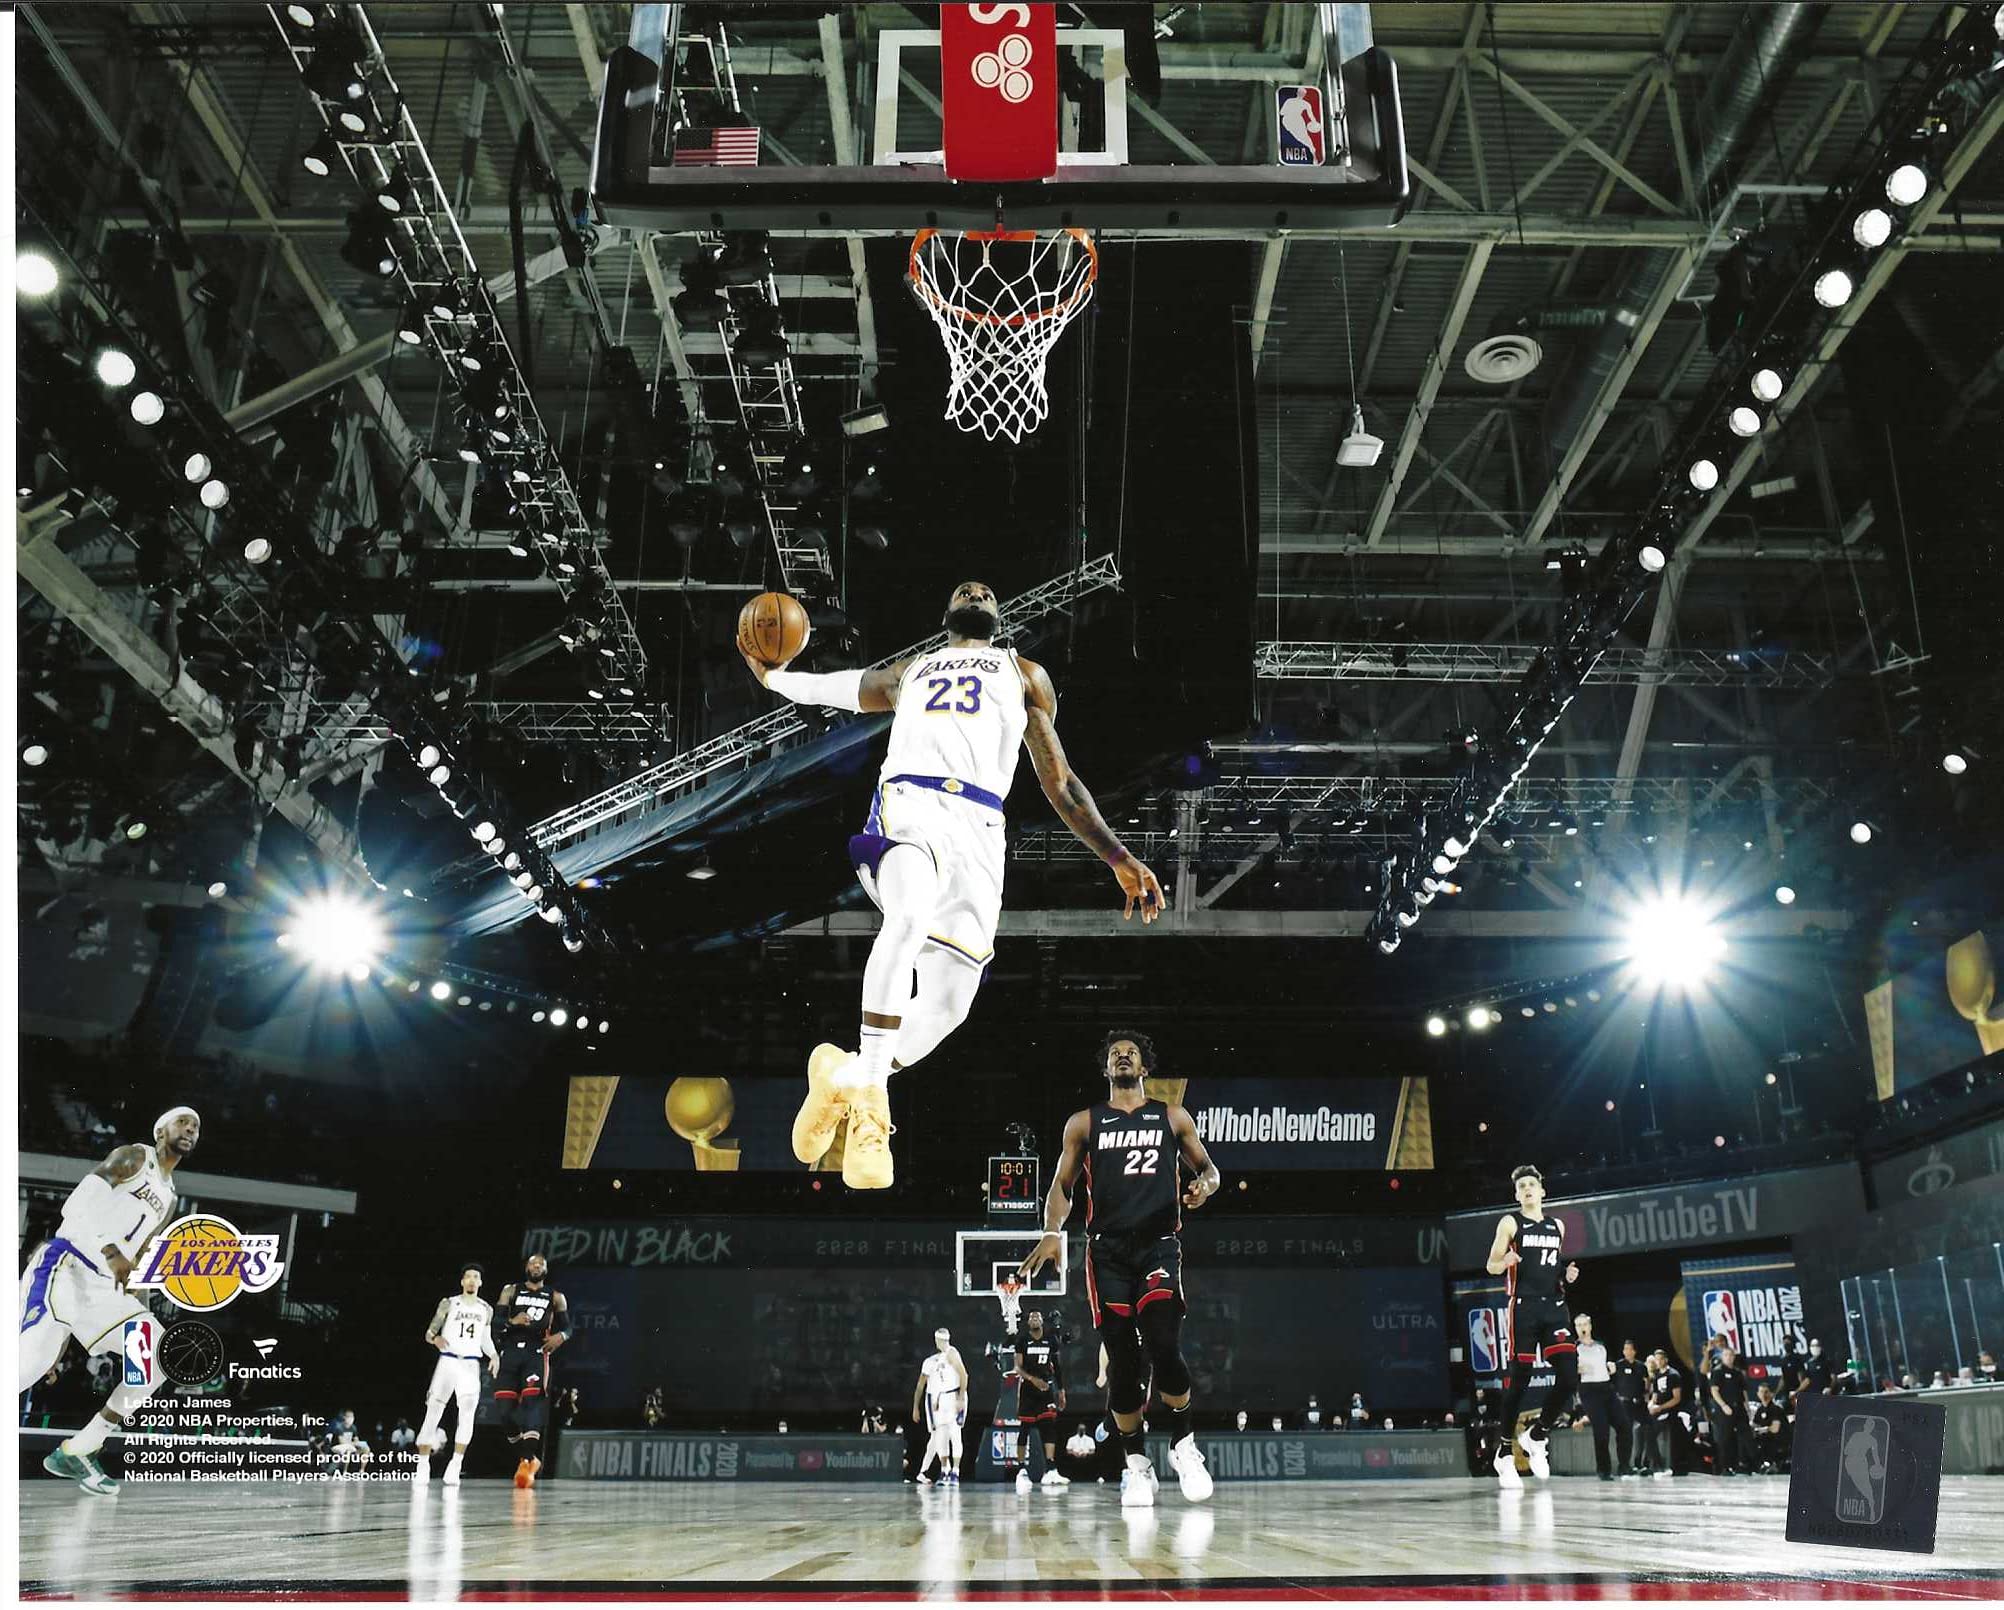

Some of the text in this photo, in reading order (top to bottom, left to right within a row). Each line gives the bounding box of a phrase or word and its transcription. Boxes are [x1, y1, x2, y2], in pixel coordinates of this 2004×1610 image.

[1285, 147, 1308, 161] NBA
[912, 657, 1002, 682] LAKERS
[925, 675, 982, 716] 23
[1196, 1106, 1376, 1144] #WholeNewGame
[1098, 1129, 1163, 1150] MIAMI
[1000, 1162, 1032, 1175] 10:01
[1123, 1149, 1159, 1175] 22
[998, 1175, 1028, 1198] 21
[124, 1213, 146, 1242] 1
[597, 1228, 629, 1264] IN
[631, 1225, 732, 1266] BLACK
[815, 1239, 951, 1256] 2020 FINAL
[1215, 1239, 1365, 1257] 2020 FINALS
[1522, 1234, 1560, 1248] MIAMI
[1539, 1249, 1558, 1266] 14
[1737, 1286, 1804, 1323] NBA 2020
[459, 1322, 475, 1338] 14
[570, 1314, 620, 1329] LTRA
[1371, 1314, 1438, 1329] ULTRA
[589, 1441, 632, 1476] NBA
[639, 1441, 713, 1478] FINALS
[715, 1441, 739, 1478] 2020
[1206, 1441, 1280, 1478] FINALS
[1282, 1440, 1307, 1476] 2020
[1842, 1497, 1866, 1517] NBA
